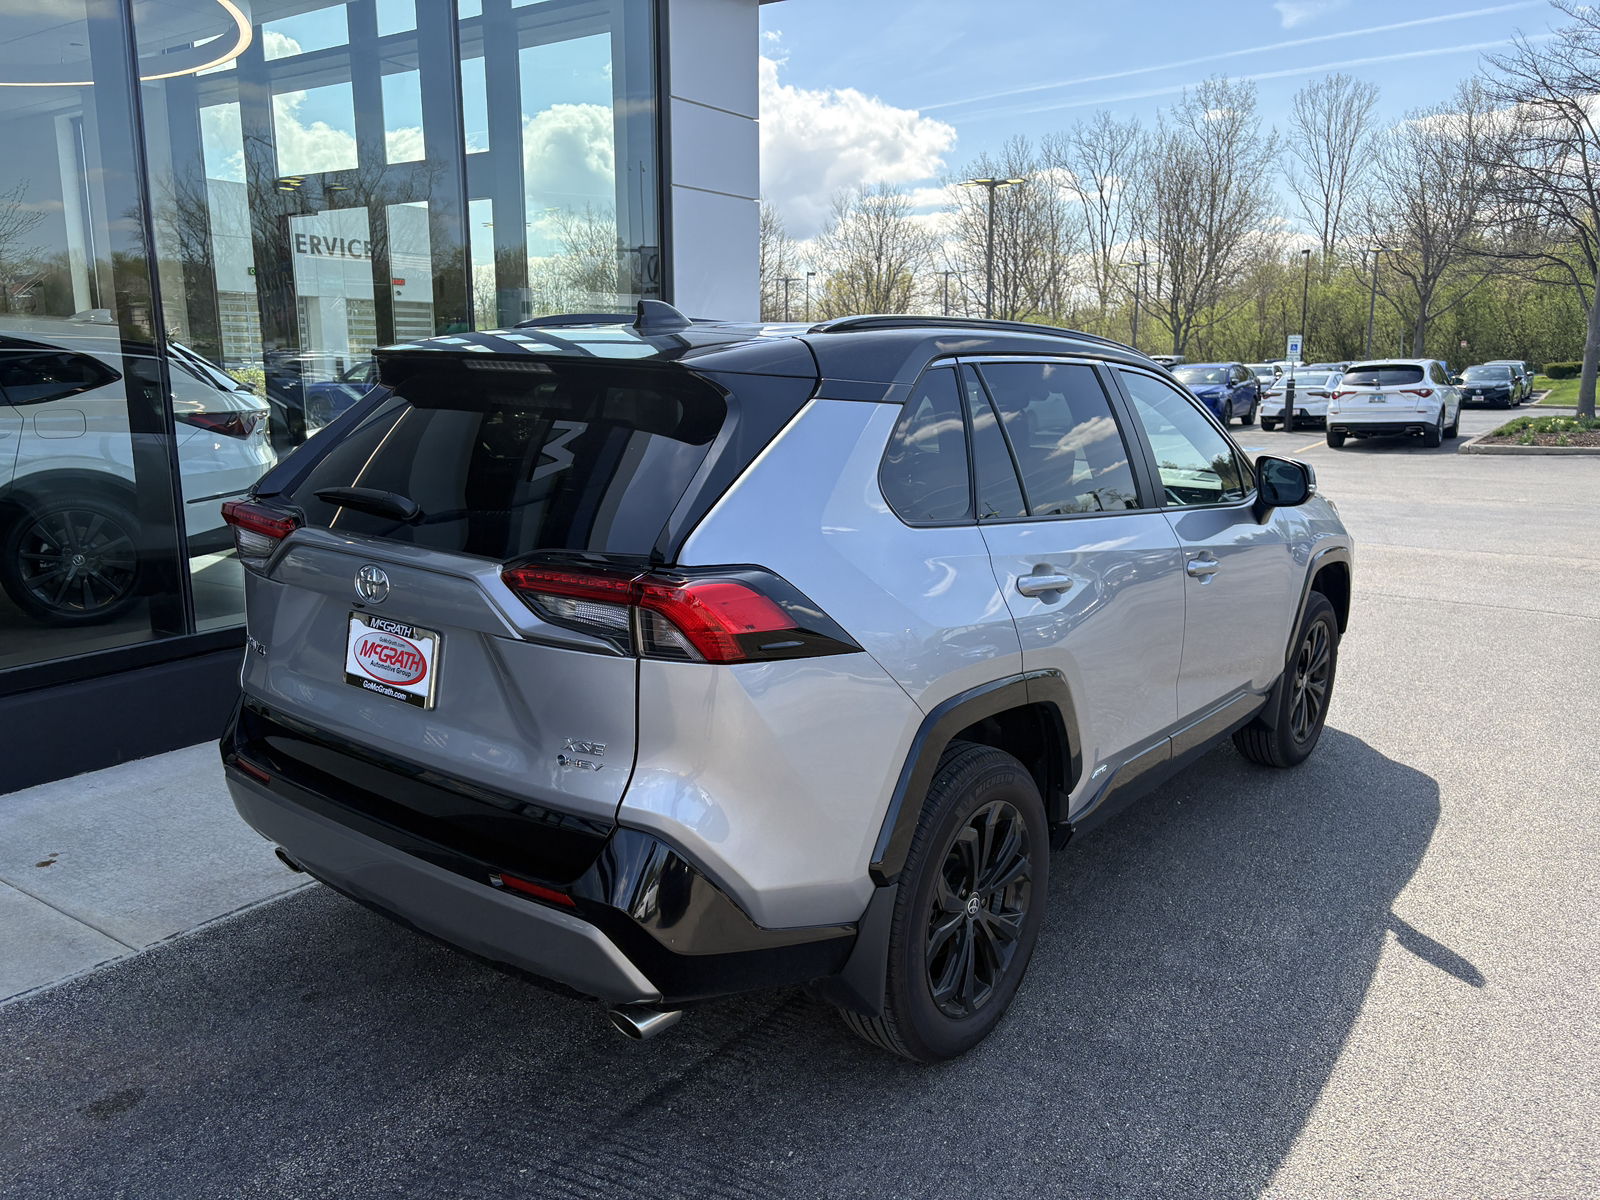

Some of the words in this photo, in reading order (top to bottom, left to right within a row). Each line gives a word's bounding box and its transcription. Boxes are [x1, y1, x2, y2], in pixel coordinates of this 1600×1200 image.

[370, 617, 412, 637] McGRATH
[359, 639, 420, 672] McGRATH
[369, 660, 396, 673] Automotive
[395, 667, 412, 678] Group
[362, 680, 407, 701] GoMcGrath.com
[560, 737, 607, 756] XSE
[975, 773, 1015, 798] MICHELIN
